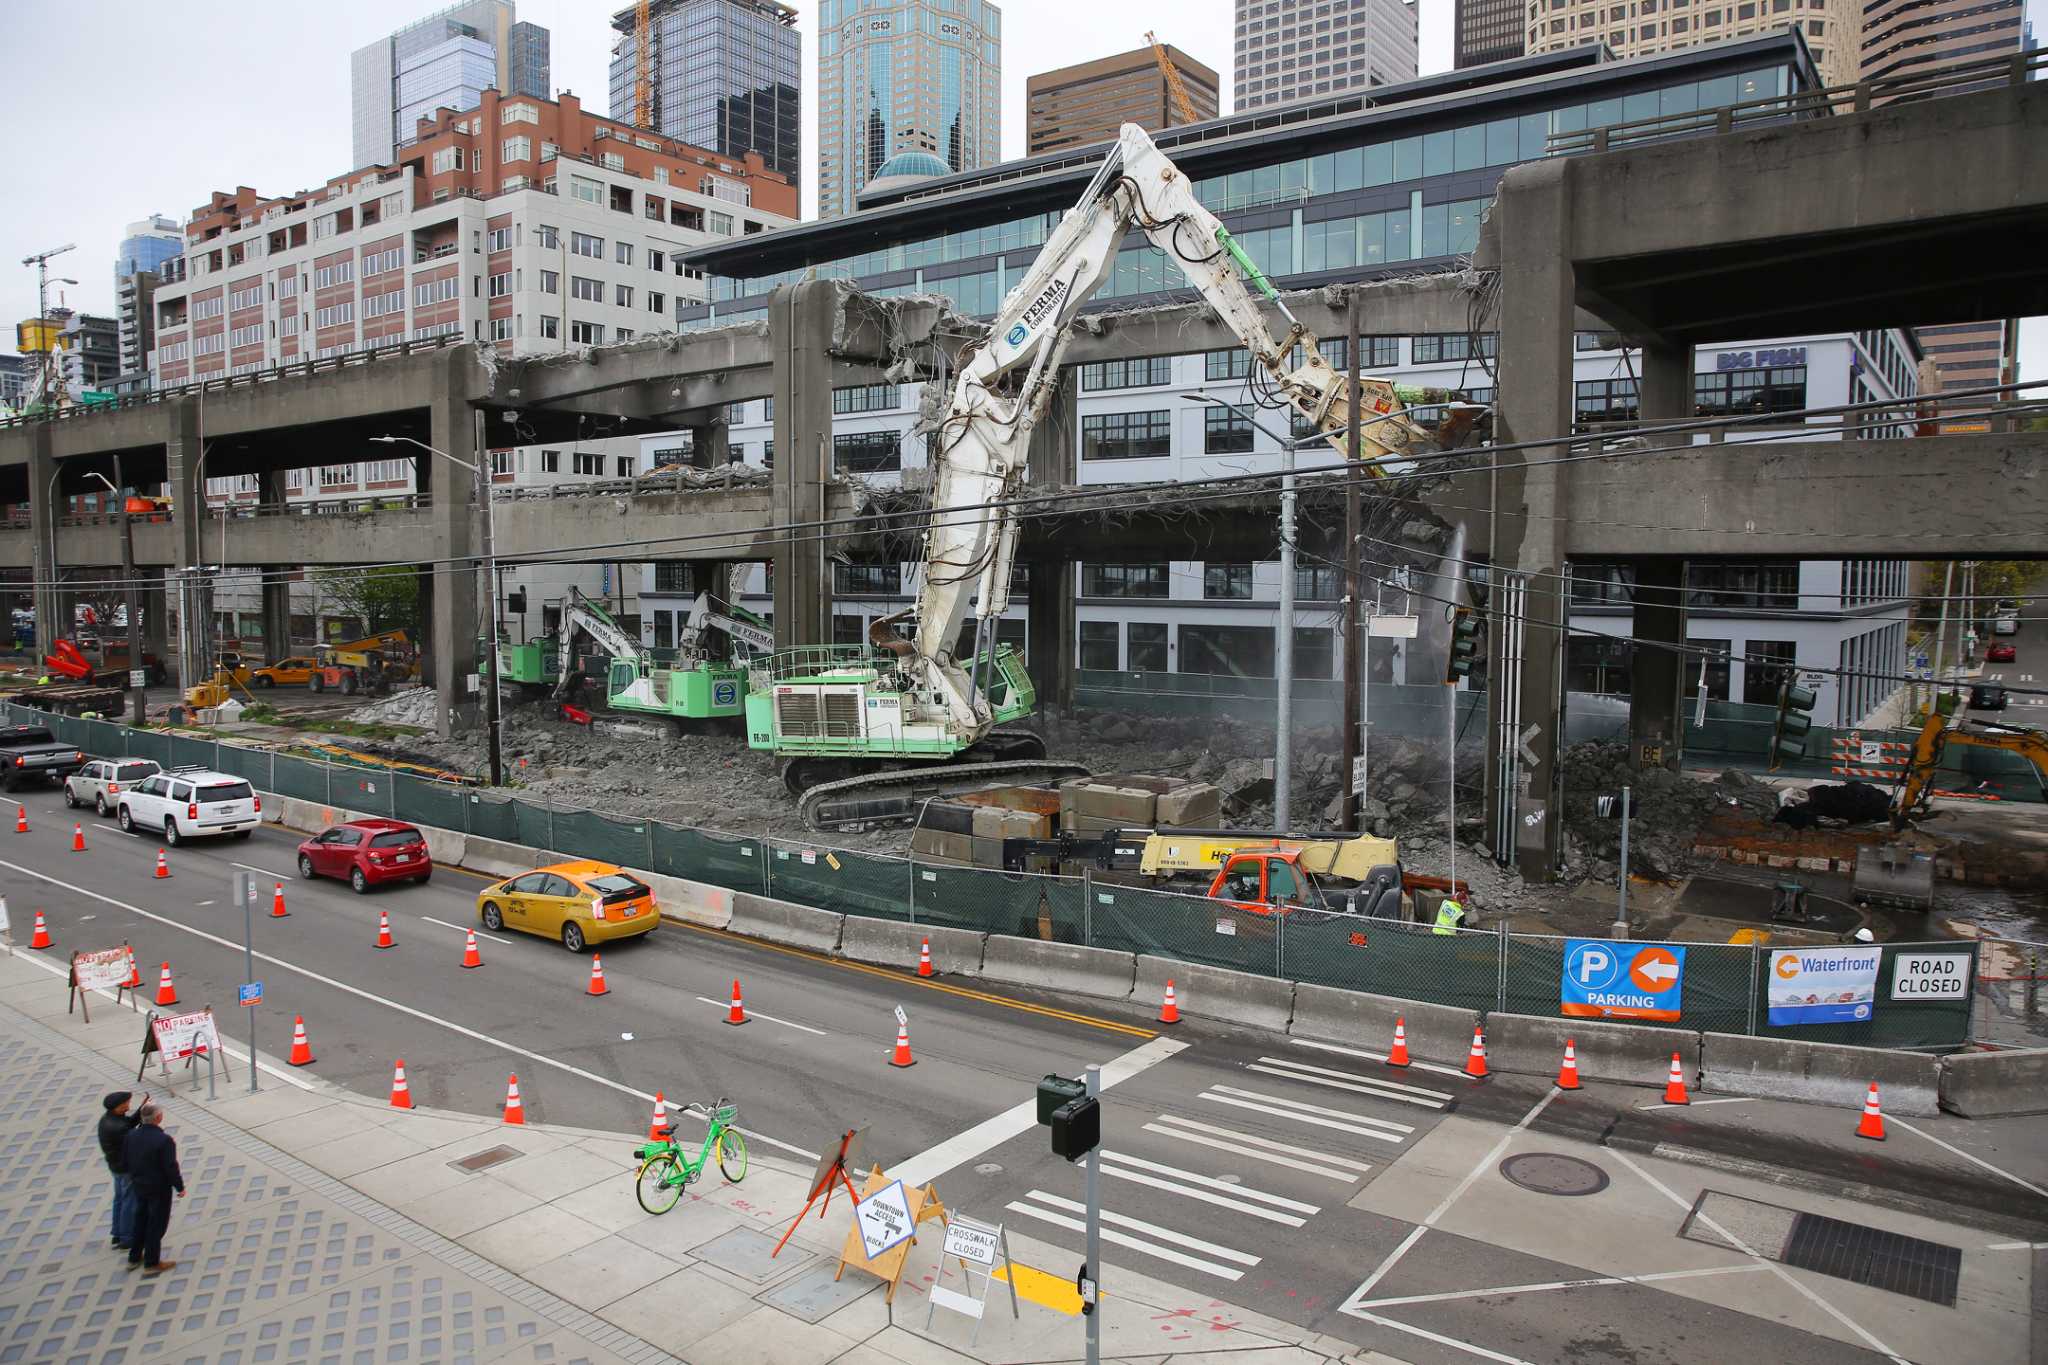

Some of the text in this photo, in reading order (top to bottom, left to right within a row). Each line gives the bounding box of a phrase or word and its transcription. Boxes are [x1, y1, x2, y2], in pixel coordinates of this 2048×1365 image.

[1022, 279, 1065, 325] FERMA
[1717, 347, 1806, 369] BIG FISH
[743, 628, 773, 647] FERMA
[1581, 951, 1608, 983] P
[1801, 957, 1875, 973] Waterfront
[1910, 960, 1954, 974] ROAD
[1899, 979, 1961, 993] CLOSED
[1588, 992, 1655, 1008] PARKING
[154, 1019, 171, 1032] NO
[872, 1199, 904, 1218] DOWNTOWN
[875, 1209, 896, 1223] ACCESS
[949, 1227, 995, 1248] CROSSWALK
[953, 1244, 985, 1259] CLOSED
